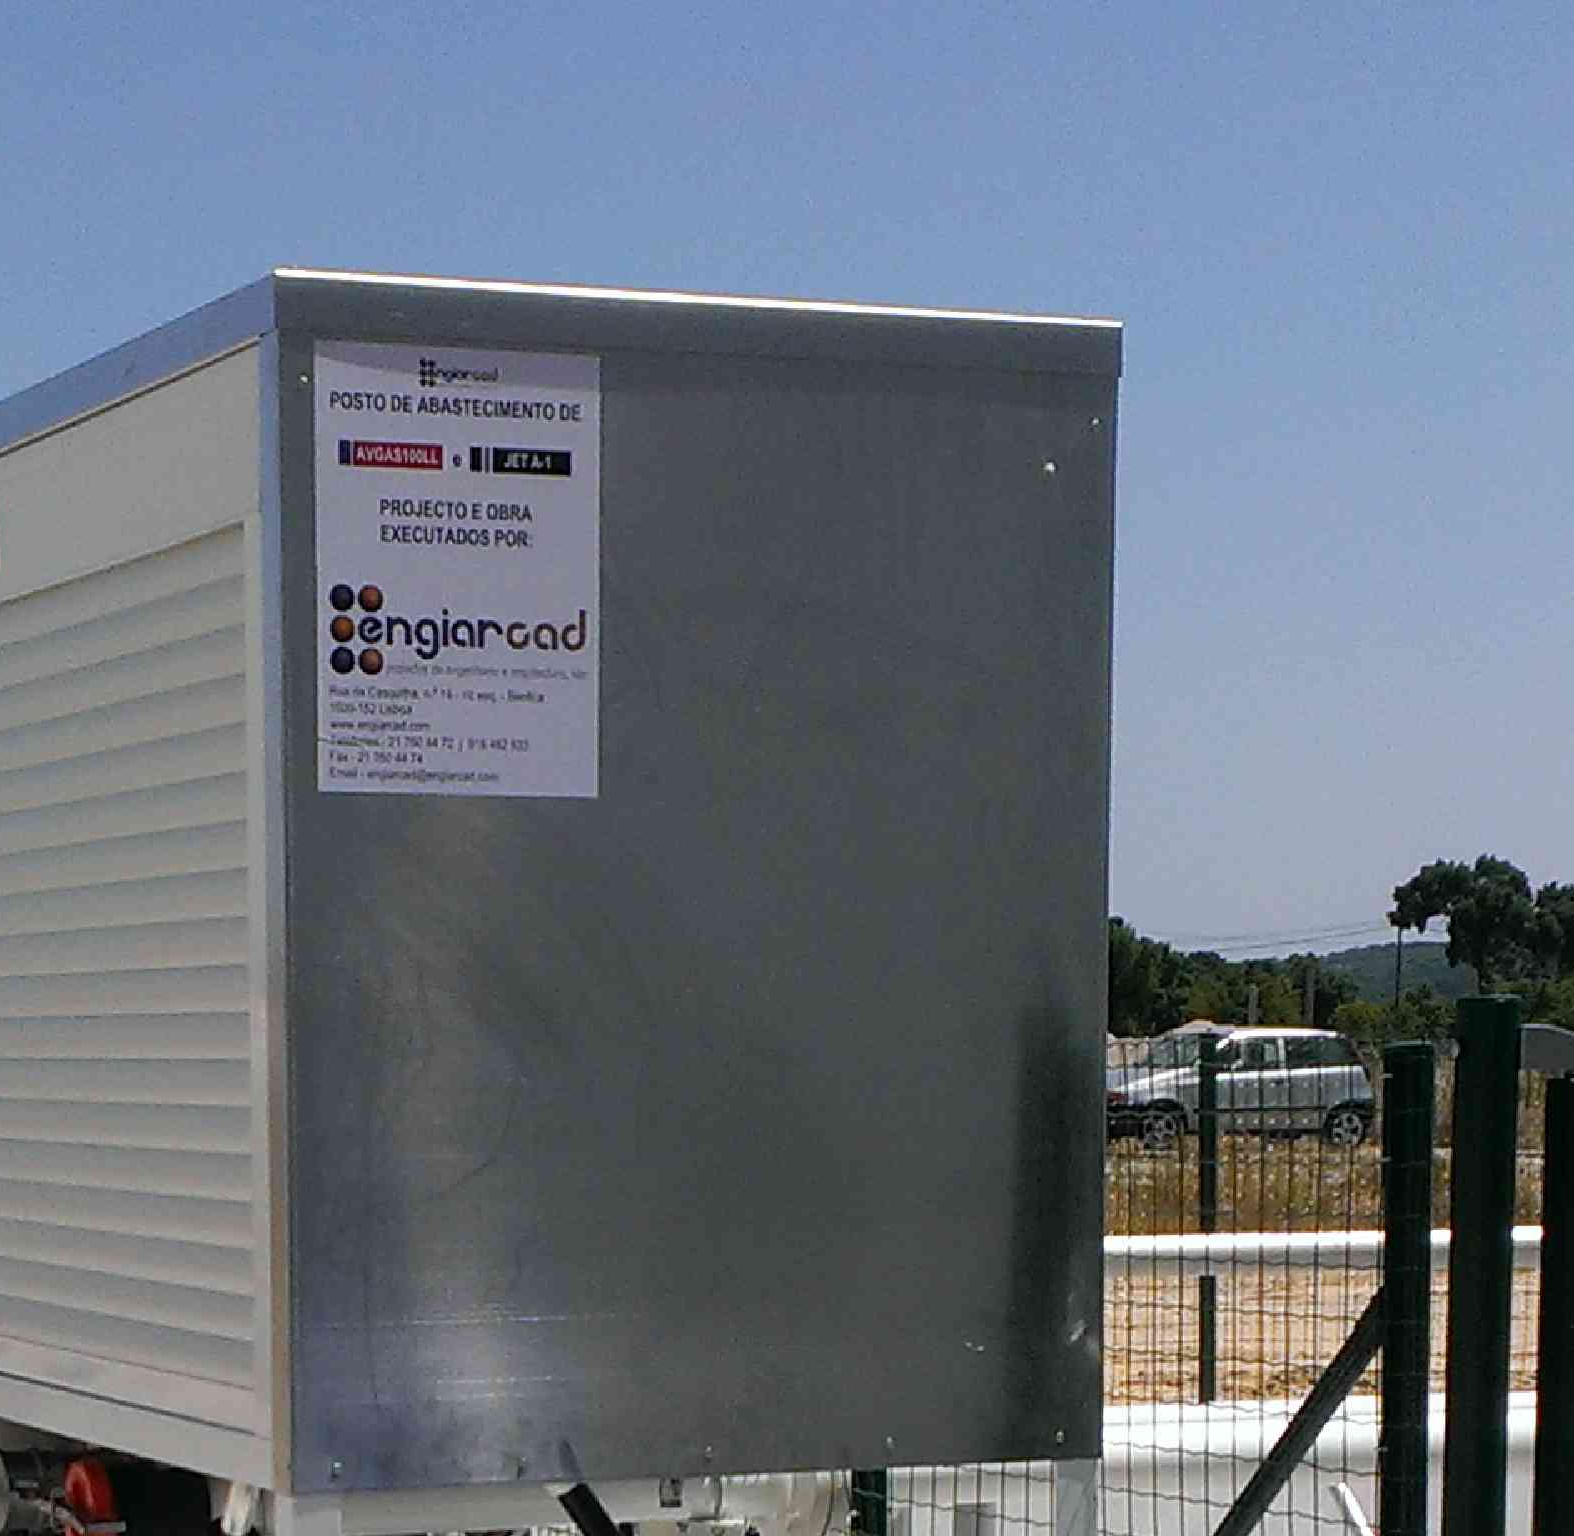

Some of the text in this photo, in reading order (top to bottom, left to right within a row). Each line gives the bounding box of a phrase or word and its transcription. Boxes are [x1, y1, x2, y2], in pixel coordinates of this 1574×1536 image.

[329, 391, 582, 422] POSTO DE ABASTECIMENTO DE
[452, 454, 462, 468] e
[379, 498, 533, 522] PROJECTO E OBRA
[380, 524, 490, 547] EXECUTADOS
[357, 608, 587, 660] engiarcad
